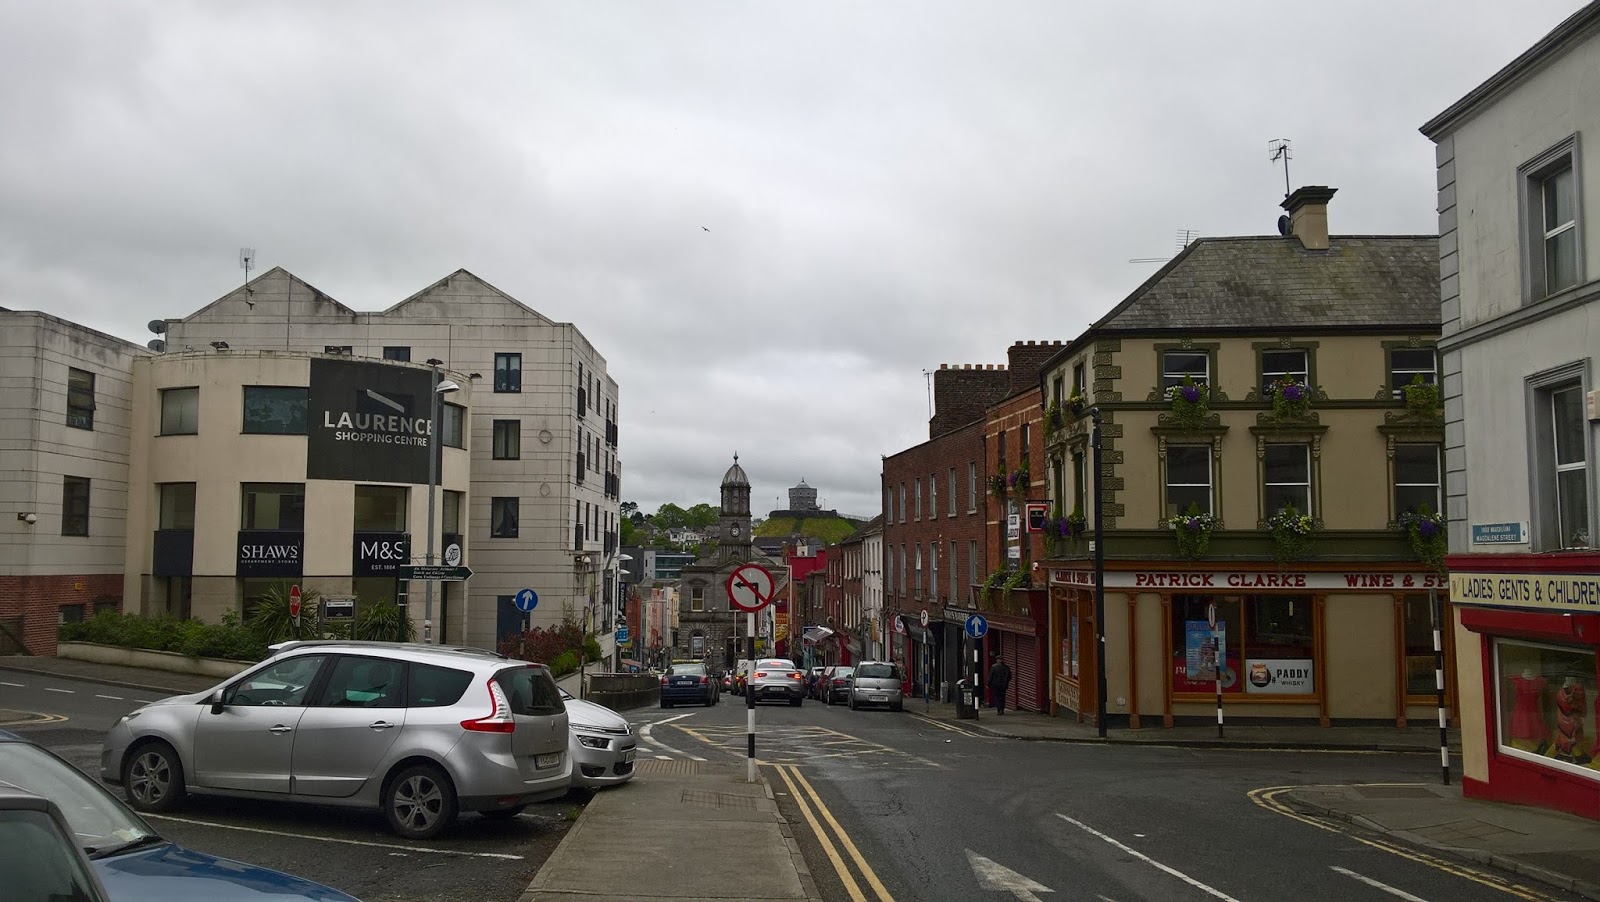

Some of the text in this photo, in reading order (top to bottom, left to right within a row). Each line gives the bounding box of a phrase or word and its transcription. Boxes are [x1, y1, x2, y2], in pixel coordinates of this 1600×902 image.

[324, 411, 432, 436] LAURENCE
[335, 431, 428, 447] SHOPPING CENTRE
[361, 541, 403, 560] M&S
[1135, 574, 1214, 588] PATRICK
[1227, 574, 1306, 588] CLARKE
[1344, 574, 1395, 588] WINE
[1402, 574, 1415, 588] &
[1462, 578, 1495, 599] LADIES,
[1499, 579, 1530, 601] GENTS
[1535, 580, 1543, 601] &
[1276, 669, 1309, 679] PADDY
